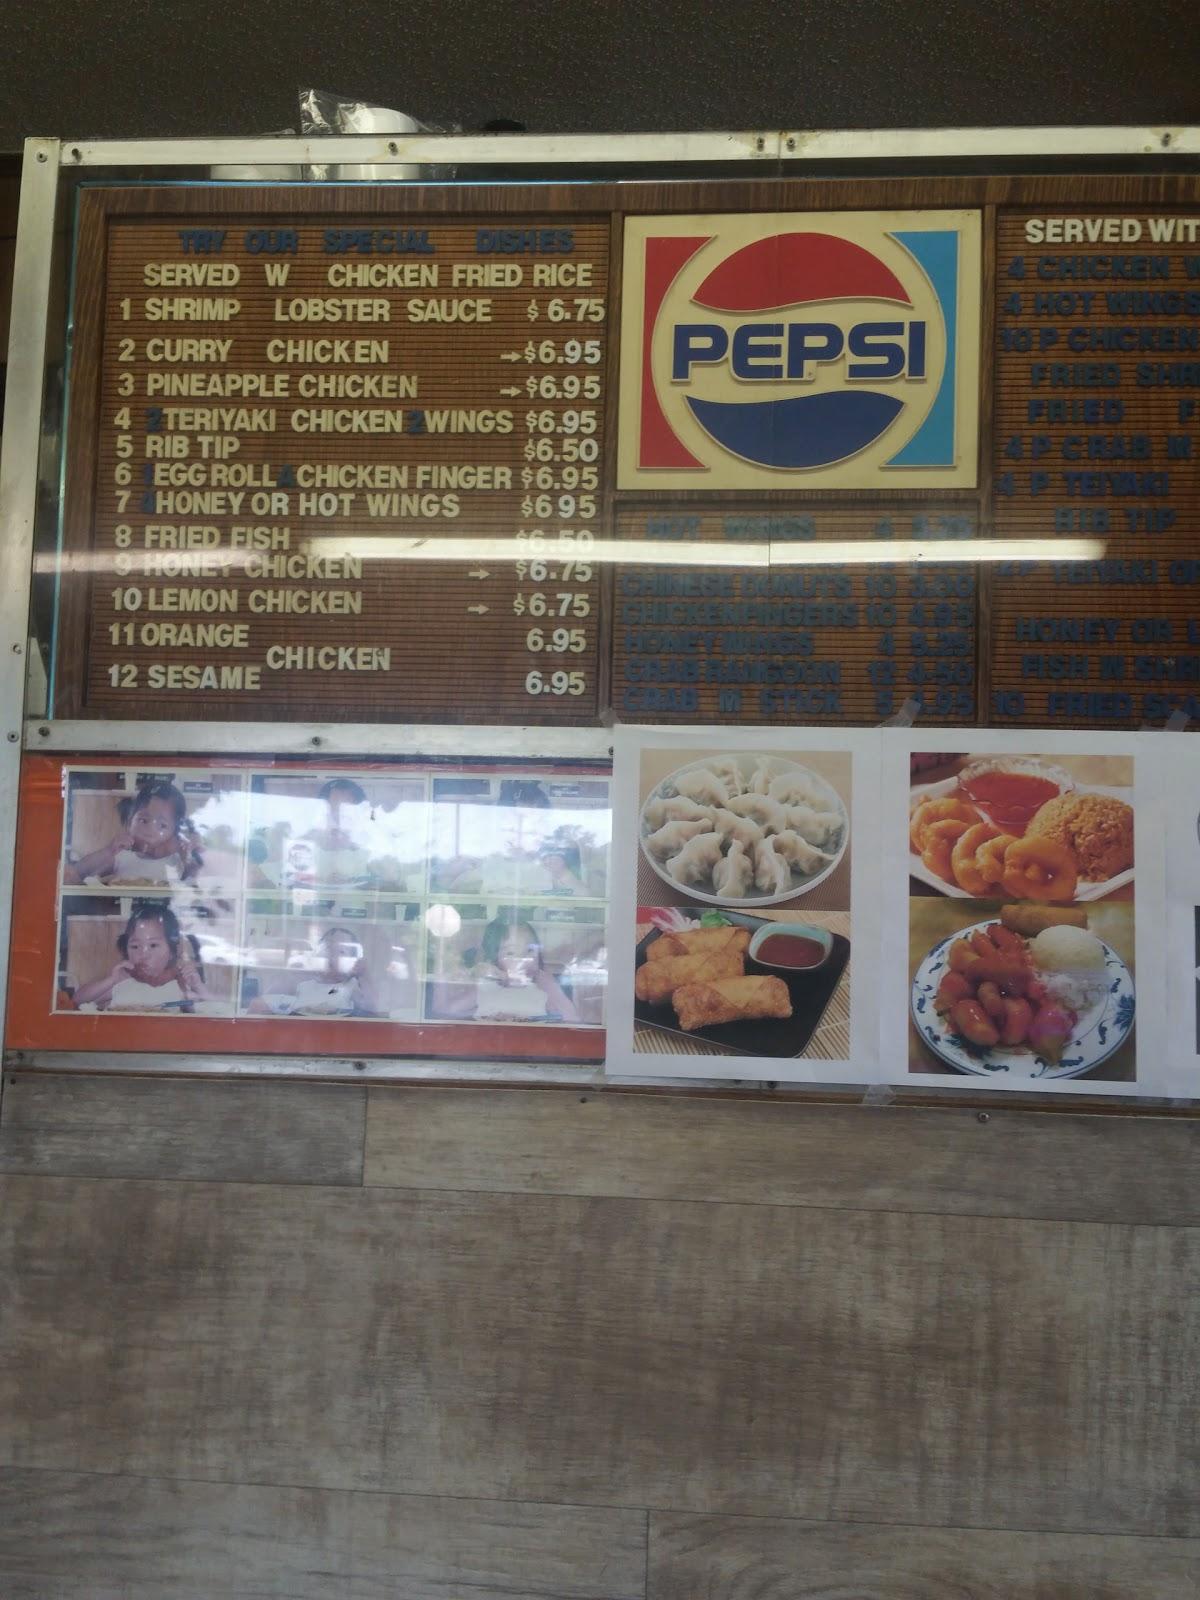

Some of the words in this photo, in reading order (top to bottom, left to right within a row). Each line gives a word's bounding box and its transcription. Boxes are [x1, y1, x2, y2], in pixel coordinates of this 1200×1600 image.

[178, 229, 226, 255] TRY
[244, 229, 299, 255] OUR
[324, 229, 436, 255] SPECIAL
[476, 229, 576, 255] DISHES
[1025, 219, 1142, 243] SERVED
[144, 263, 241, 287] SERVED
[265, 263, 290, 287] W
[327, 263, 439, 288] CHICKEN
[452, 264, 523, 288] FRIED
[533, 264, 593, 288] RICE
[1037, 256, 1169, 280] CHICKEN
[120, 298, 130, 321] 1
[145, 298, 241, 321] SHRIMP
[274, 299, 391, 321] LOBSTER
[407, 299, 492, 322] SAUCE
[1034, 290, 1095, 316] HOT
[118, 339, 135, 362] 2
[146, 339, 233, 363] CURRY
[266, 340, 389, 364] CHICKEN
[524, 339, 601, 364] $6.95
[672, 320, 926, 382] PEPSI
[1068, 327, 1200, 352] CHICKEN
[118, 373, 134, 396] 3
[147, 373, 290, 397] PINEAPPLE
[299, 374, 418, 398] CHICKEN
[526, 375, 601, 399] $6.95
[1031, 363, 1121, 388] FRIED
[114, 407, 131, 430] 4
[291, 409, 402, 433] CHICKEN
[526, 410, 597, 434] $6.95
[1028, 400, 1125, 425] FRIED
[116, 435, 134, 458] 5
[145, 435, 190, 459] RIB
[197, 435, 240, 459] TIP
[524, 437, 599, 463] $6.50
[1062, 435, 1152, 461] CRAB
[114, 462, 132, 485] 6
[416, 467, 512, 489] FINGER
[521, 466, 599, 490] $6.95
[115, 490, 131, 513] 7
[251, 492, 289, 516] OR
[299, 492, 355, 516] HOT
[366, 493, 460, 517] WINGS
[1055, 507, 1109, 533] RIB
[1123, 507, 1178, 533] TIP
[115, 525, 132, 549] 8
[144, 526, 220, 549] FRIED
[231, 527, 290, 551] FISH
[114, 552, 131, 576] 9
[143, 552, 234, 577] HONEY
[244, 554, 362, 579] CHICKEN
[515, 558, 592, 582] $6.75
[622, 573, 733, 598] CHINESE
[740, 573, 852, 598] DONUTS
[111, 588, 142, 611] 10
[148, 588, 238, 612] LEMON
[248, 590, 362, 614] CHICKEN
[513, 592, 590, 617] $6.75
[109, 623, 135, 646] 11
[141, 623, 249, 648] ORANGE
[526, 628, 586, 653] 6.95
[1016, 616, 1121, 642] HONEY
[266, 645, 391, 671] CHICKEN
[1022, 655, 1089, 681] FISH
[108, 664, 138, 688] 12
[148, 664, 261, 690] SESAME
[525, 671, 585, 695] 6.95
[623, 659, 701, 684] CRAB
[623, 687, 699, 713] CRAB
[1048, 691, 1133, 718] FRIED
